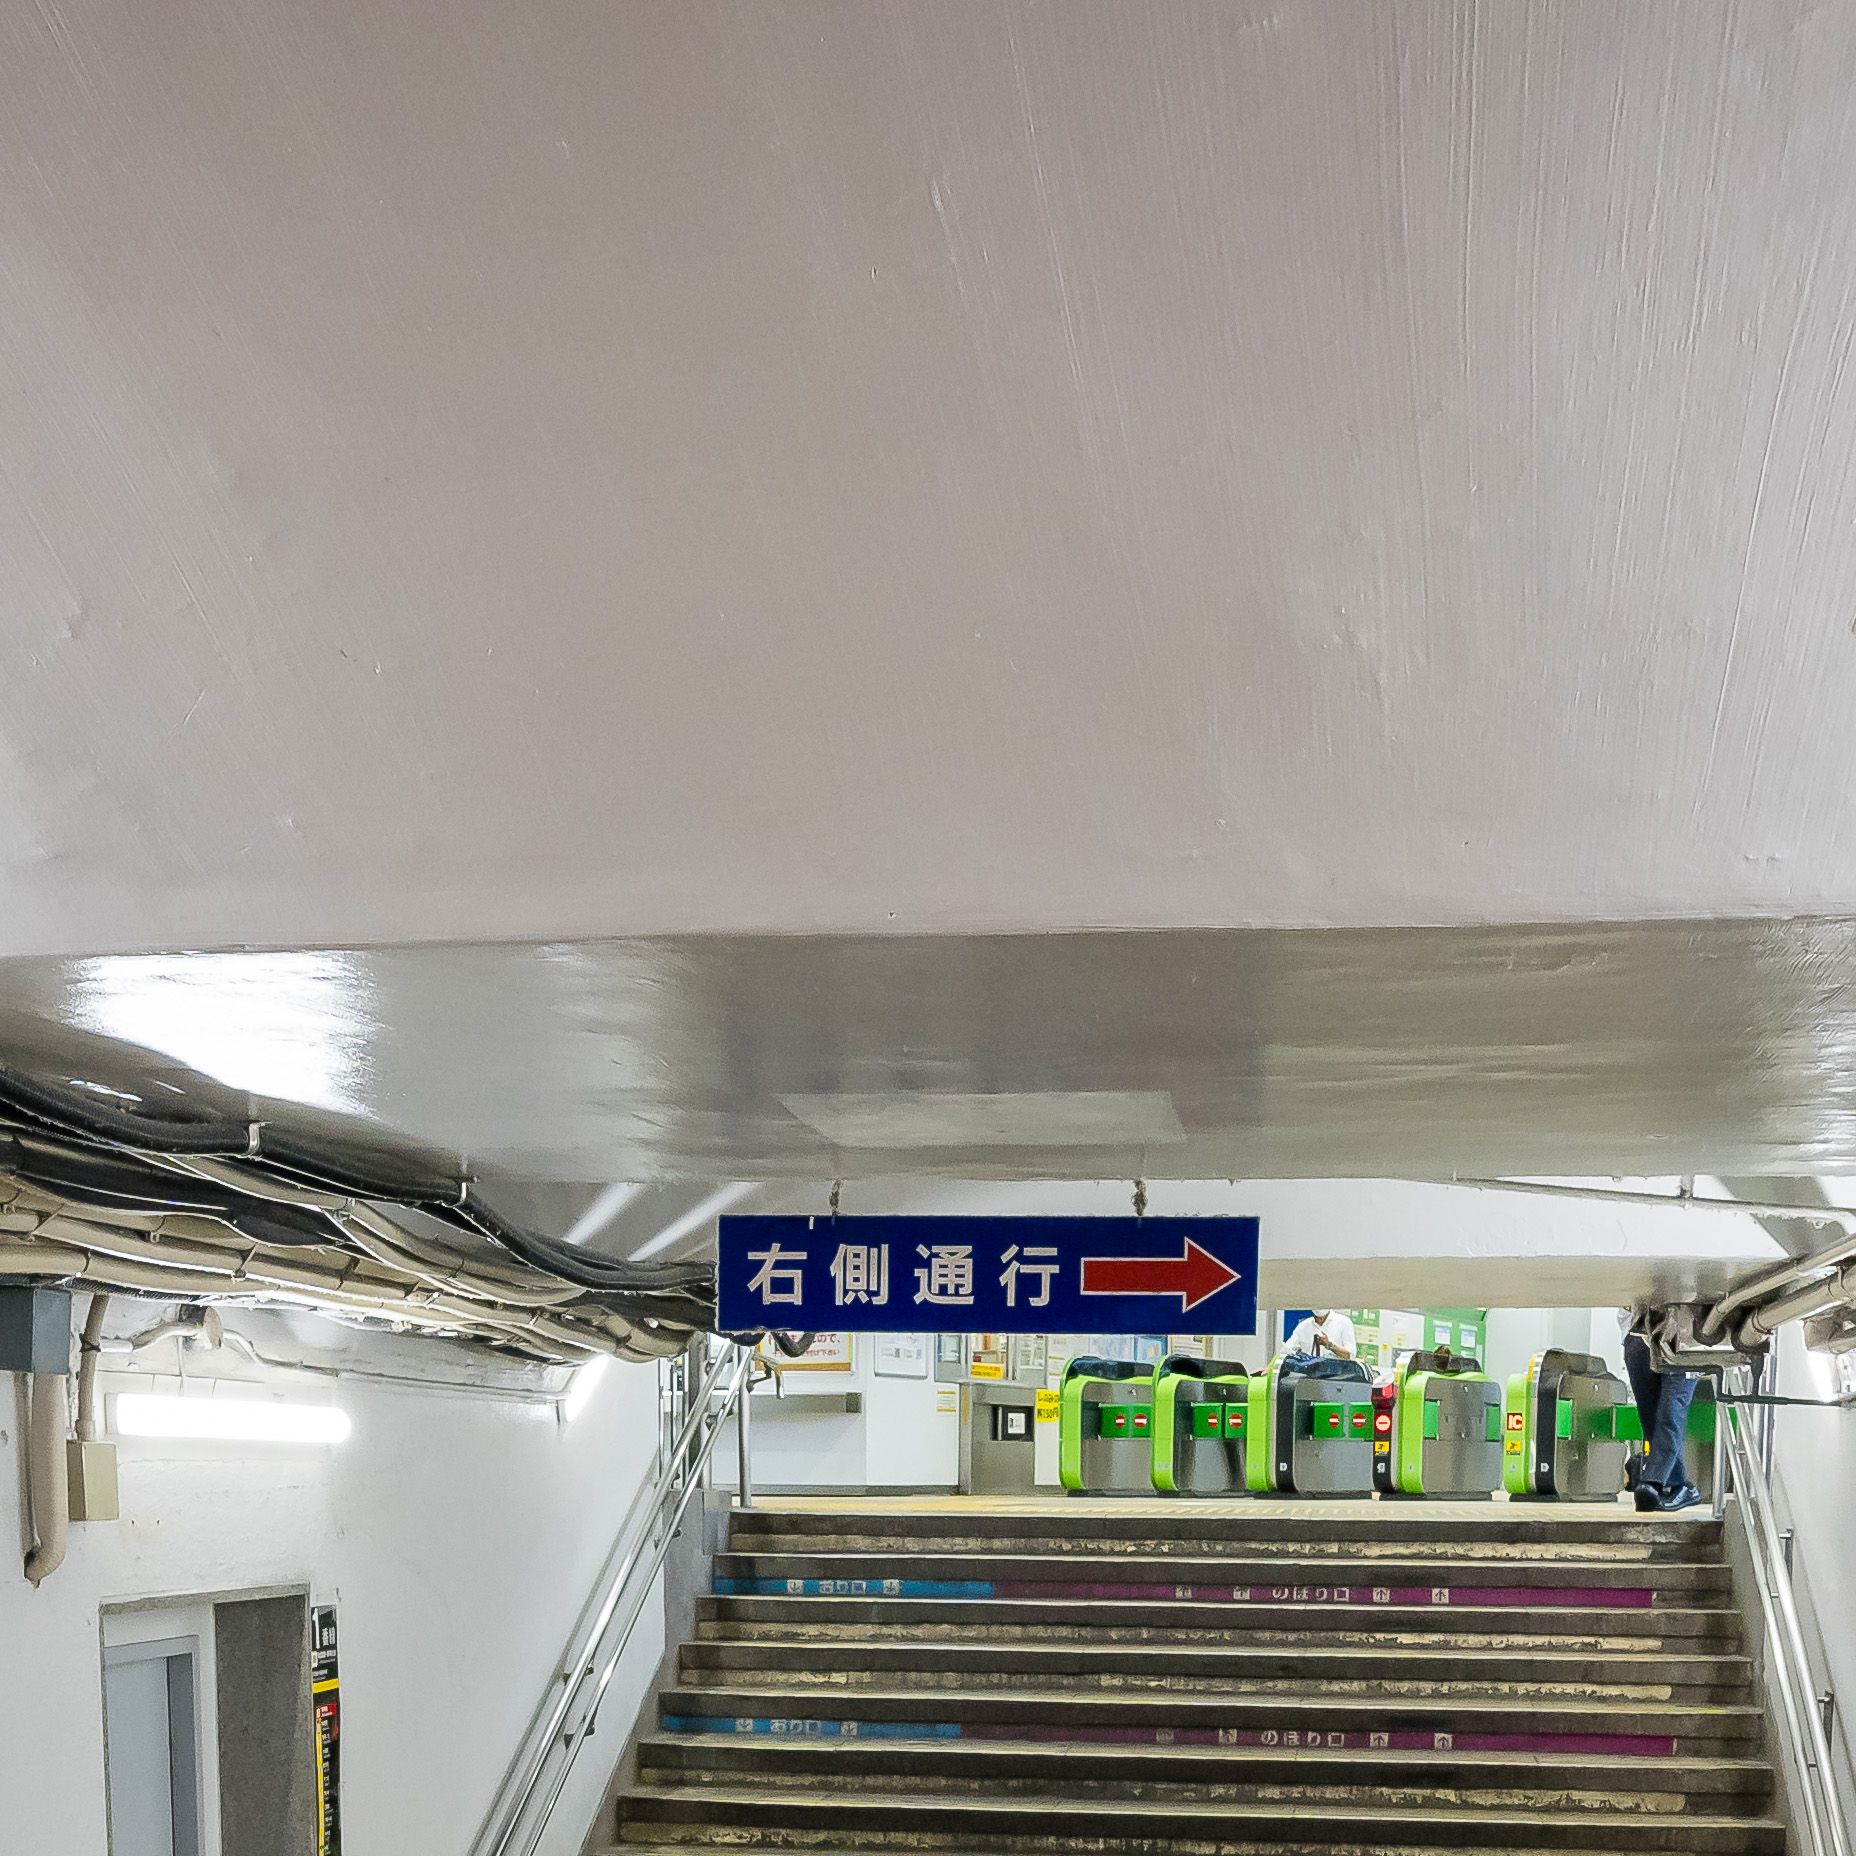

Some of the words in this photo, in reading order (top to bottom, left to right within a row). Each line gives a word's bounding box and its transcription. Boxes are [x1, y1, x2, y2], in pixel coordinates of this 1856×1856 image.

[747, 1242, 1060, 1307] 右側通行
[1508, 1414, 1523, 1430] IC
